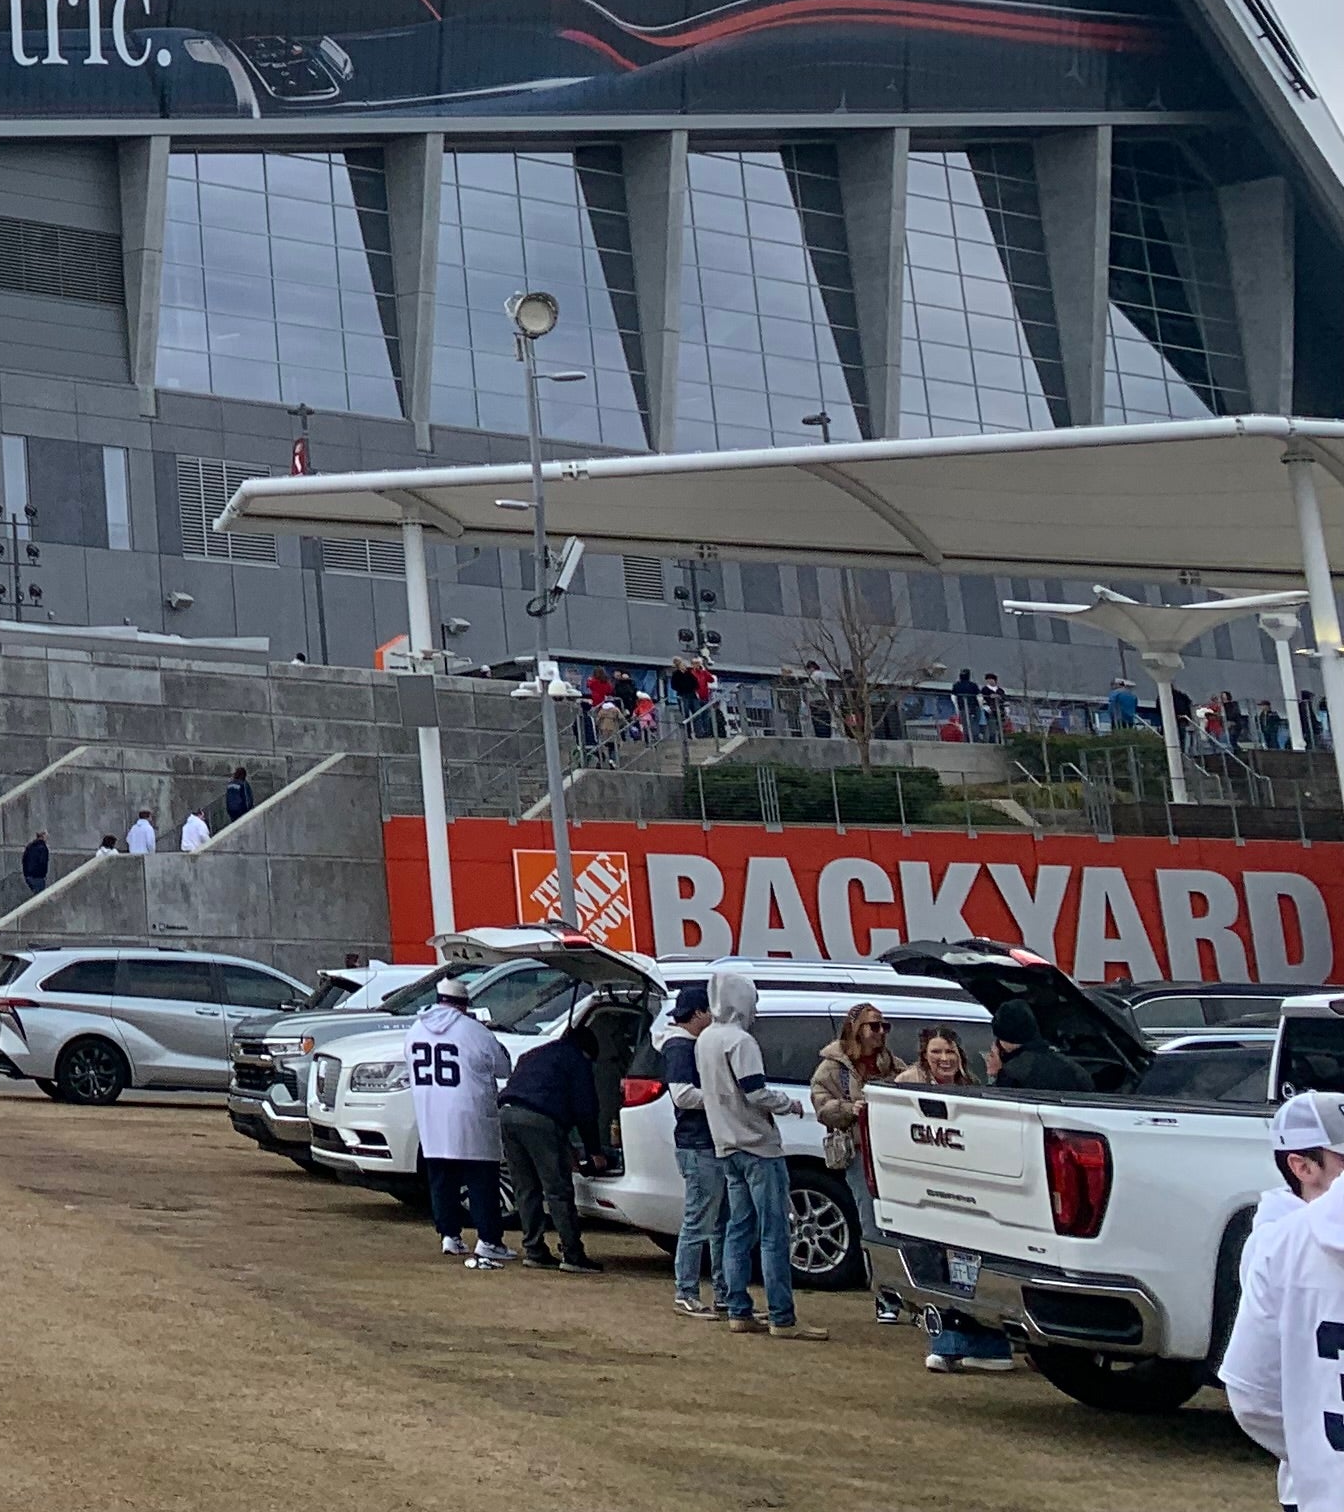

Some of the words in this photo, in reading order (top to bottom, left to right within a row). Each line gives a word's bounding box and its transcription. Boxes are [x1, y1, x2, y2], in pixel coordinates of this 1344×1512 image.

[529, 867, 560, 908] TH
[645, 853, 1332, 986] BACKYARD
[411, 1042, 461, 1088] 26
[910, 1123, 966, 1151] GMC
